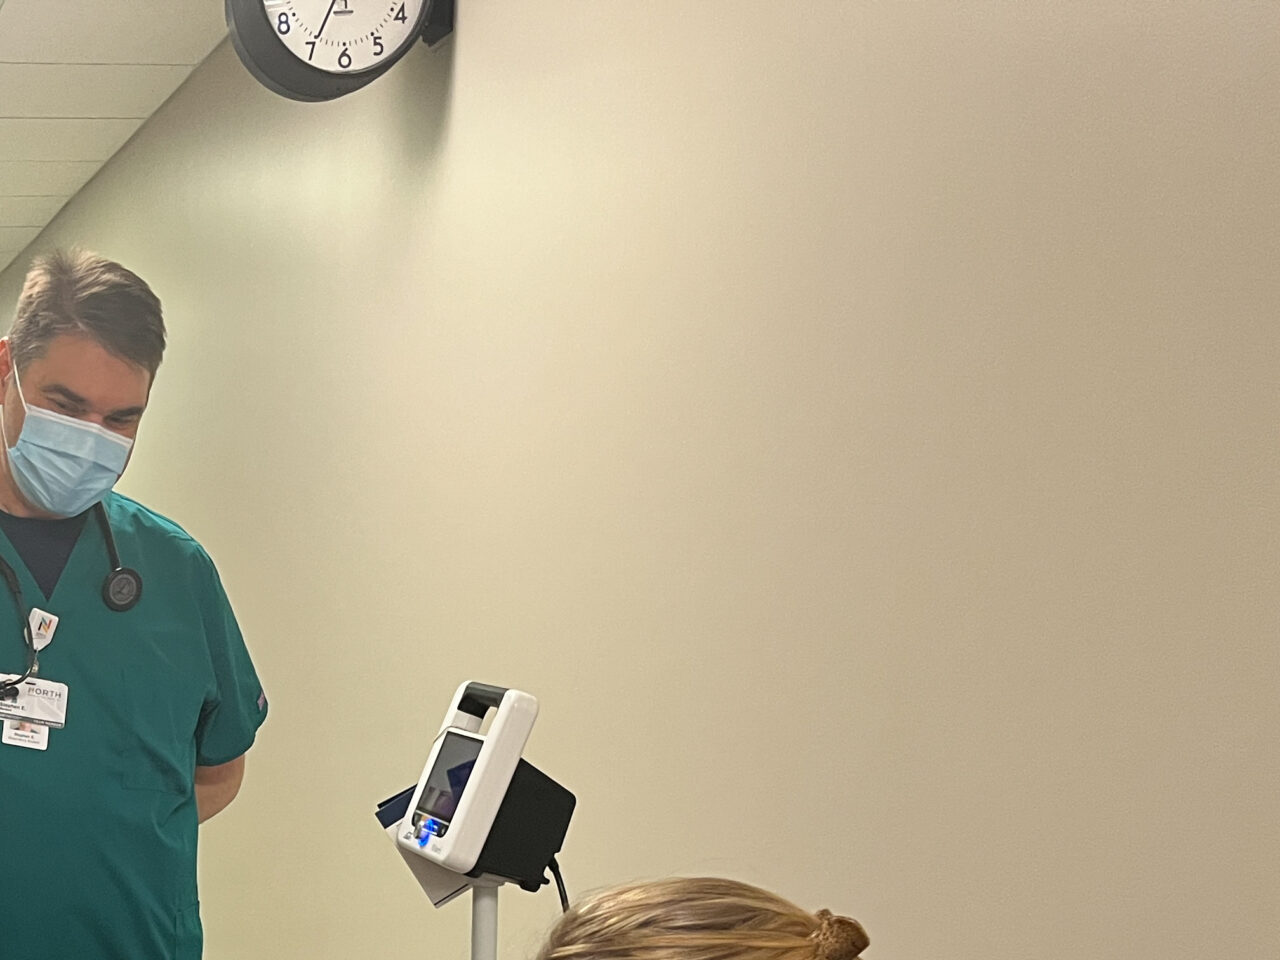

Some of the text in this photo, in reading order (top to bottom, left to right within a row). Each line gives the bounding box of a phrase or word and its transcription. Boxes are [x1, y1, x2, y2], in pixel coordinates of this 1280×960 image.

[277, 12, 291, 35] 8
[393, 3, 408, 24] 4
[305, 41, 317, 61] 7
[373, 36, 384, 56] 5
[337, 48, 352, 68] 6
